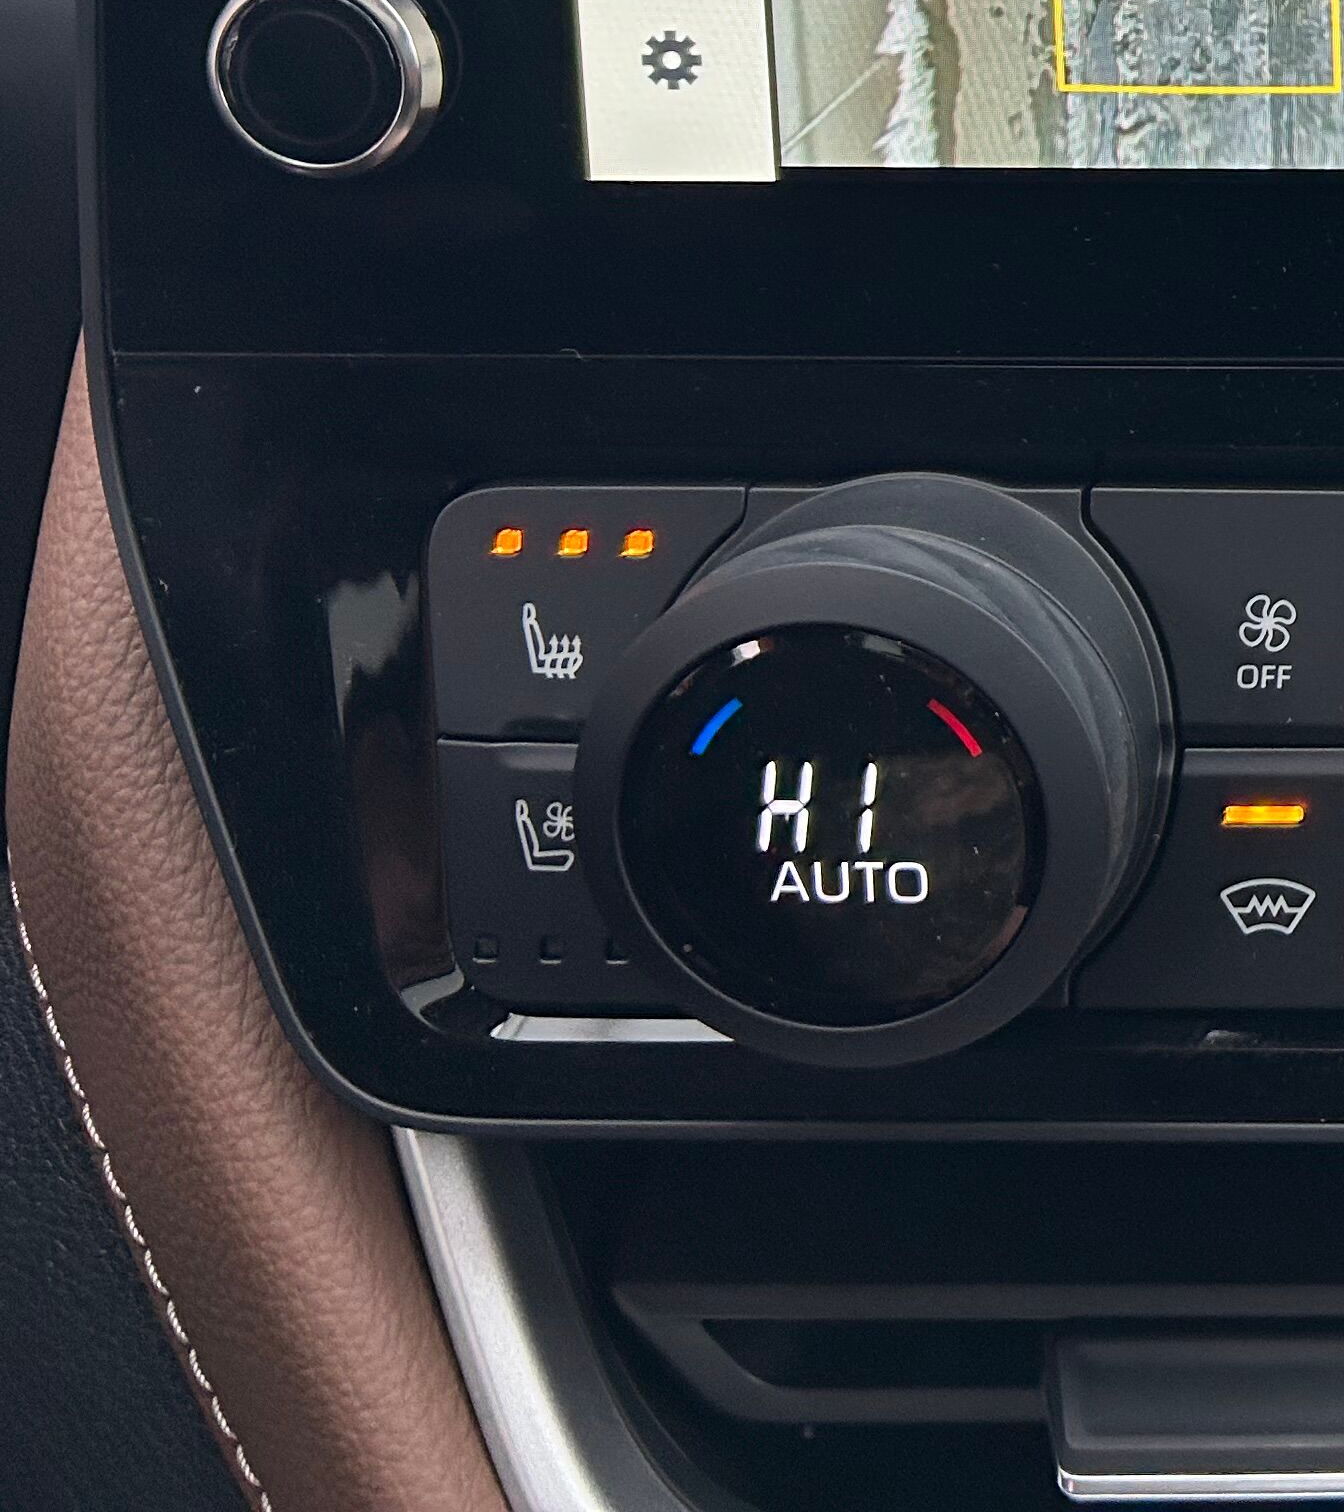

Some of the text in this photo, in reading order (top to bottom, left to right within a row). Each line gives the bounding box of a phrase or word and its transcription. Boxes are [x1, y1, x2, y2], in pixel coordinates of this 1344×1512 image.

[1236, 664, 1293, 689] OFF
[757, 760, 878, 854] HI
[770, 860, 930, 904] AUTO
